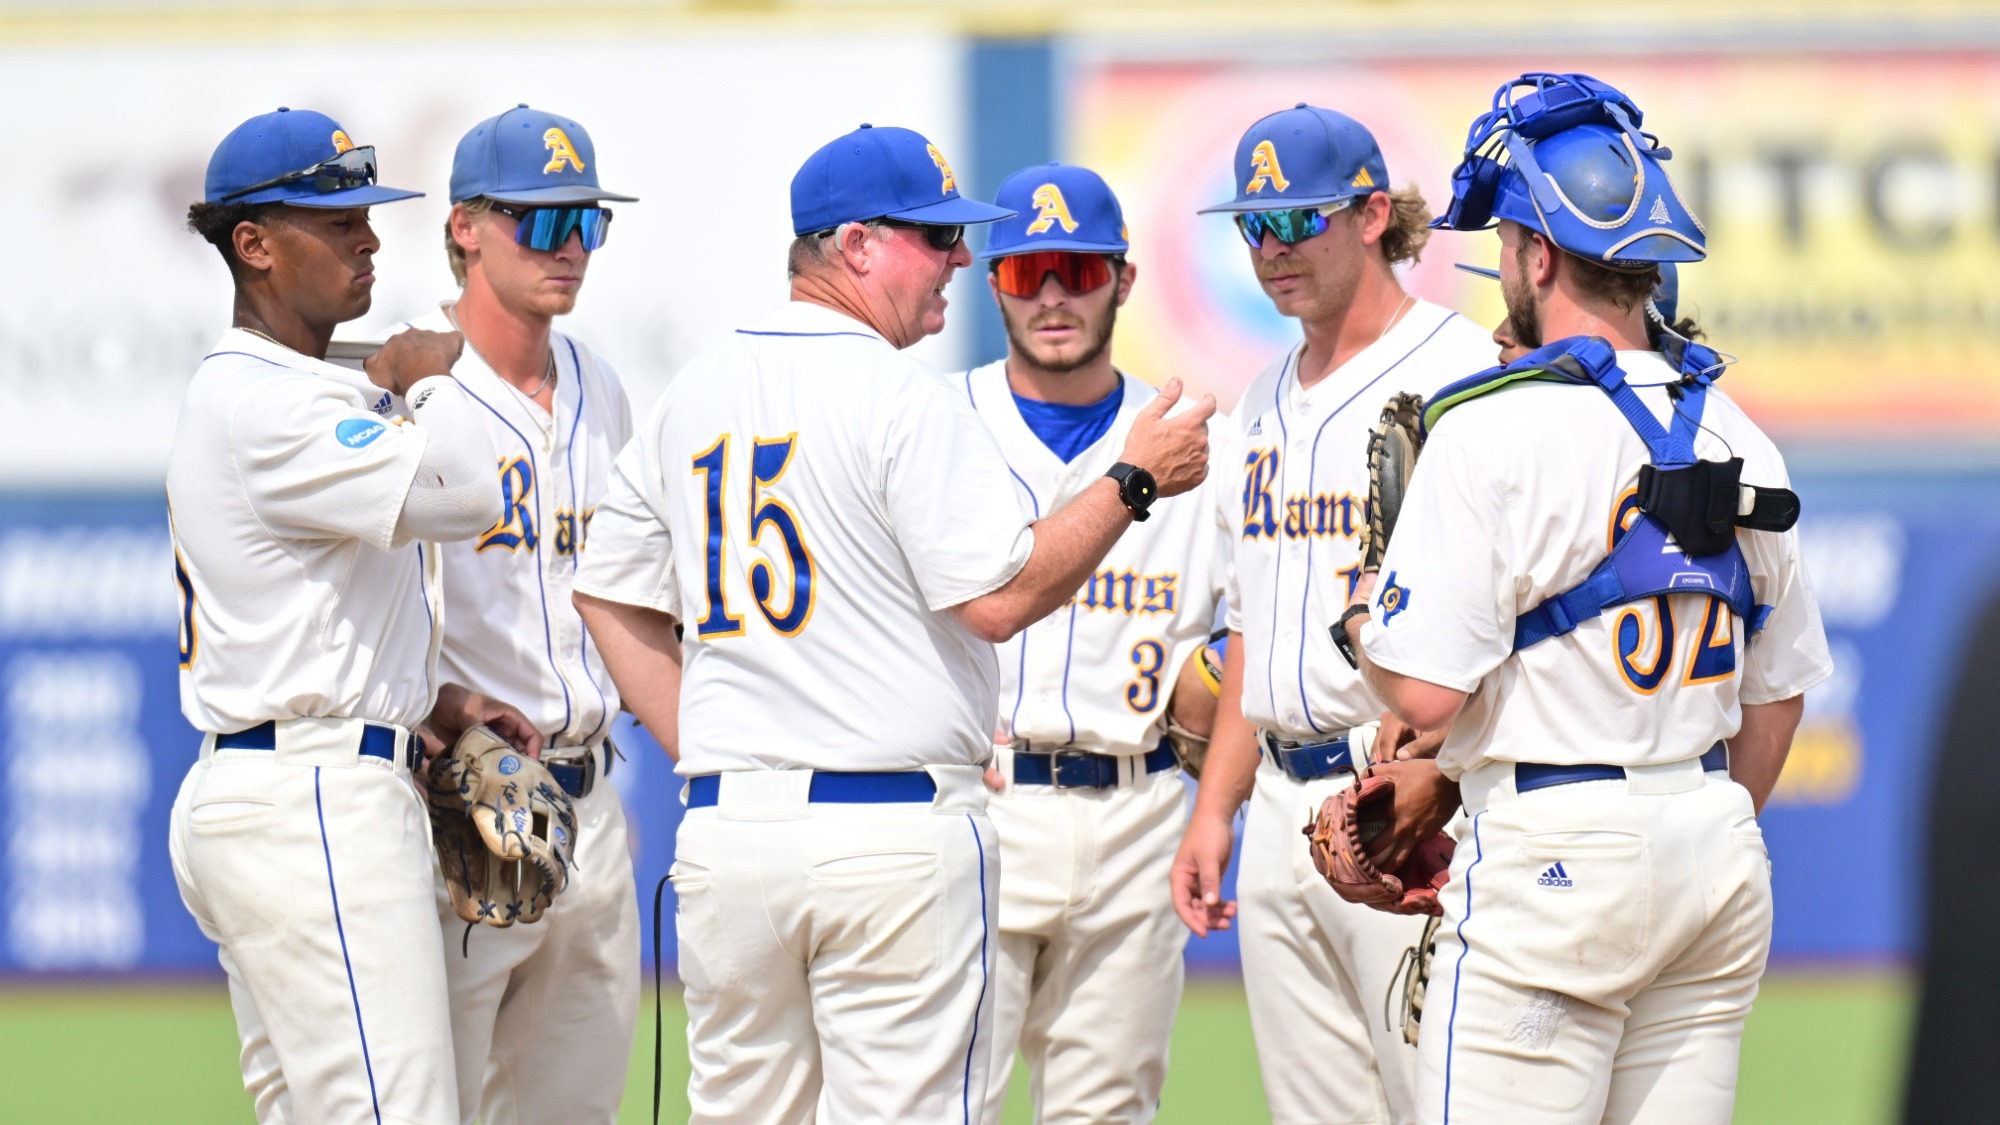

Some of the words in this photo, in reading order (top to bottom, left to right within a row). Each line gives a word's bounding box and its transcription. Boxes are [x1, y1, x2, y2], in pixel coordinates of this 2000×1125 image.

[543, 127, 586, 175] A
[1245, 139, 1290, 195] A
[1026, 183, 1079, 236] A
[347, 424, 384, 445] NCAA
[474, 454, 596, 556] Ra
[1241, 444, 1370, 544] Ram
[692, 431, 818, 641] 15
[1063, 566, 1179, 617] ms
[1124, 636, 1167, 716] 3
[1537, 876, 1573, 888] adidas
